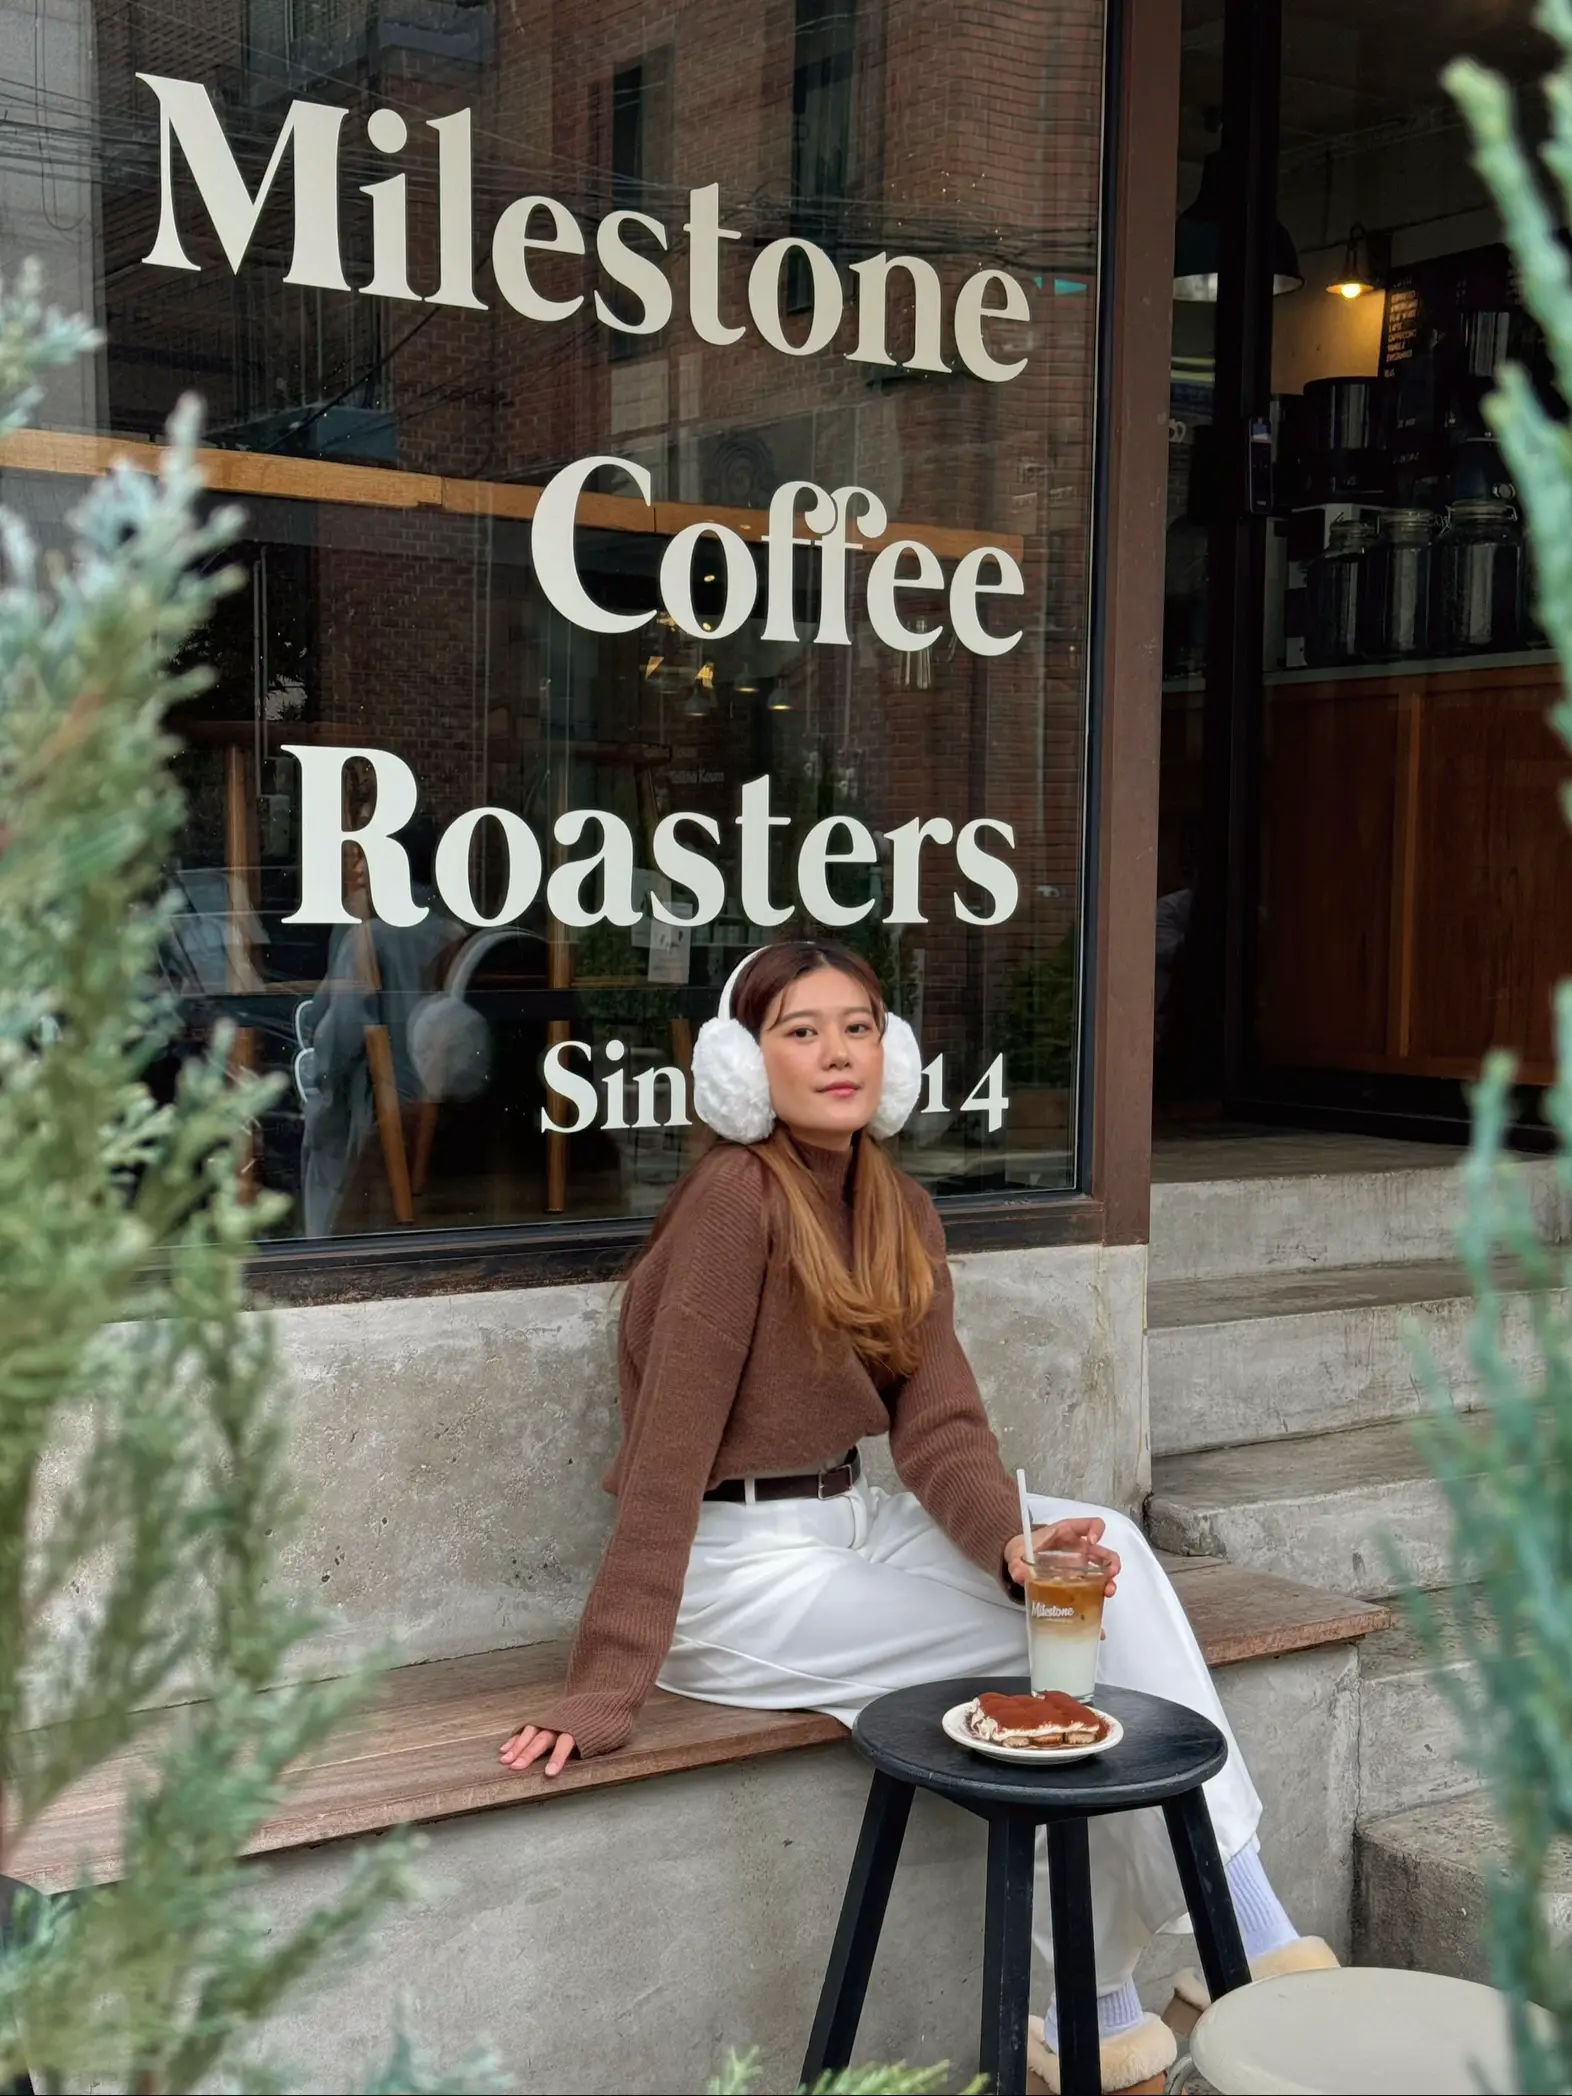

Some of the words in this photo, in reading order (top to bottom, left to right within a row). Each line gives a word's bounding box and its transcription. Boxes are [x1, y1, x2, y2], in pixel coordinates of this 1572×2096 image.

[135, 72, 1031, 382] Milestone
[531, 455, 1025, 656] Coffee
[280, 744, 1019, 928] Roasters
[541, 1039, 706, 1133] Sin
[920, 1052, 1009, 1133] 14
[1031, 1600, 1075, 1618] Milestone
